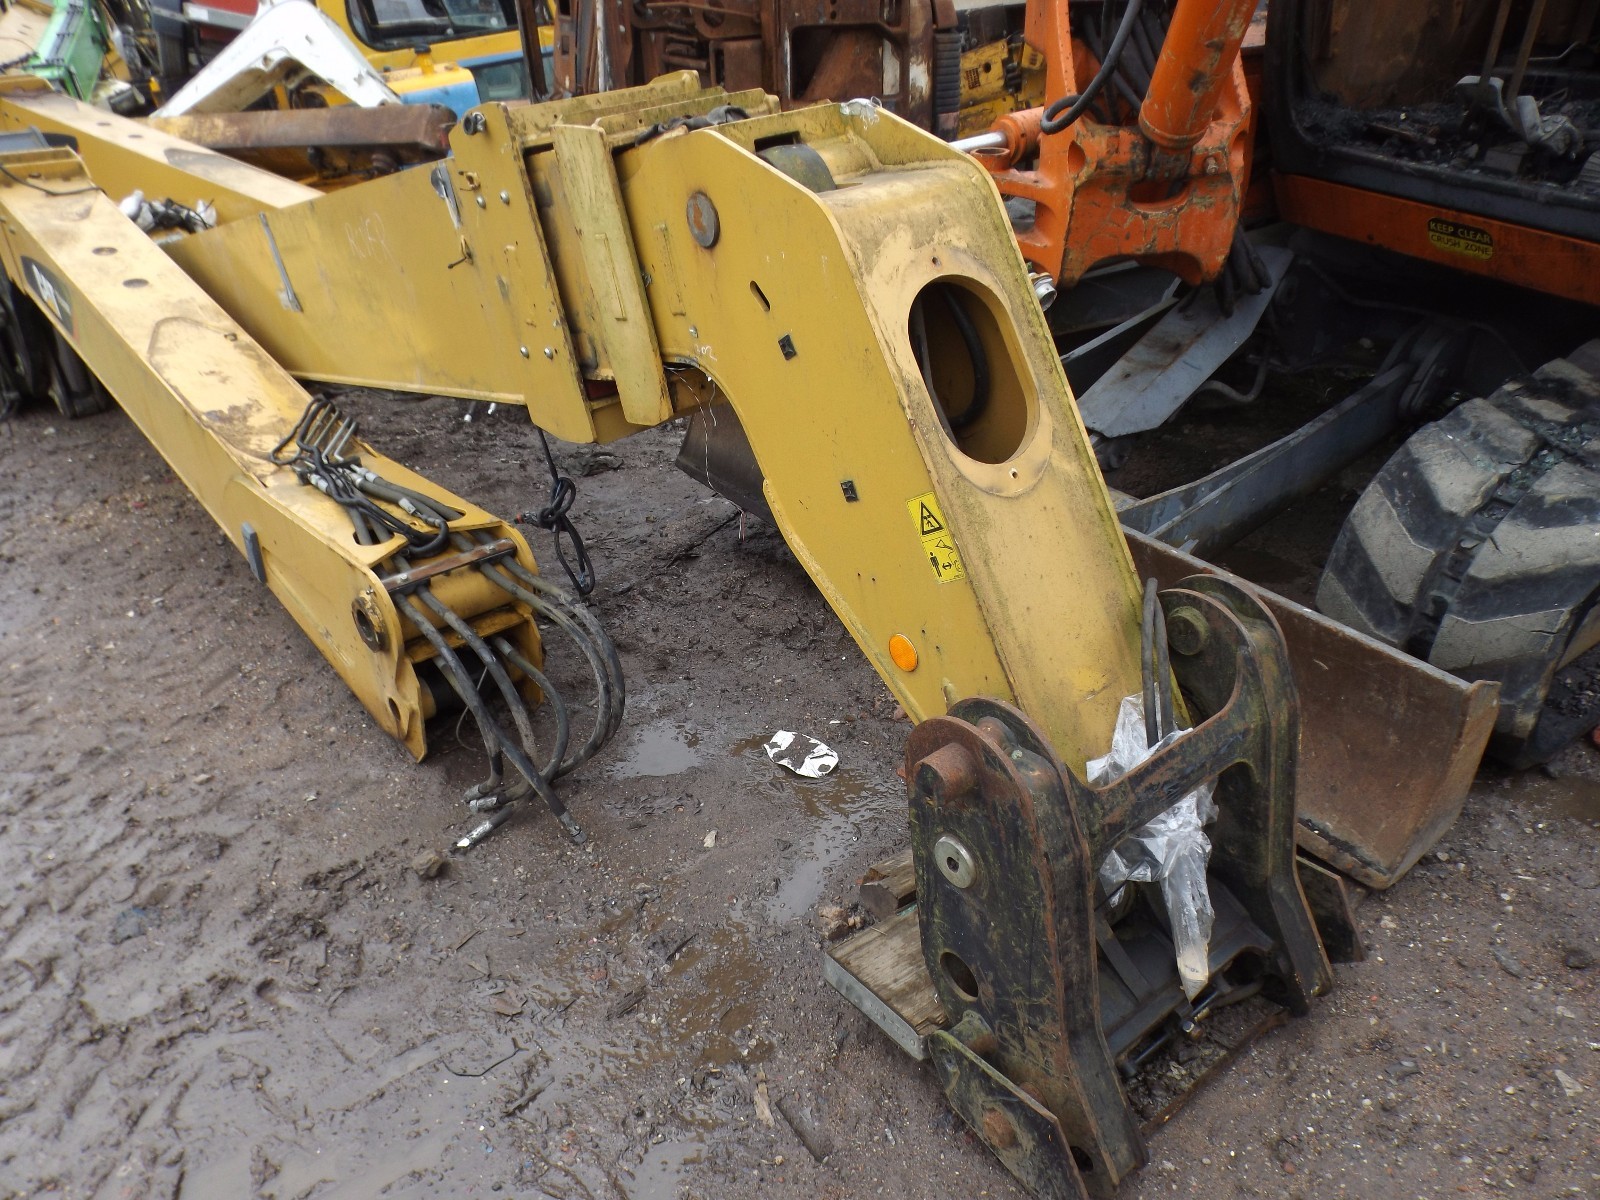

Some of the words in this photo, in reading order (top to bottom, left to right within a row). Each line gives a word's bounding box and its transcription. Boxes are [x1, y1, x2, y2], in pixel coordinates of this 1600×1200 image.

[1430, 221, 1454, 233] KEEP
[1457, 228, 1491, 244] CLEAR
[1431, 234, 1461, 248] CRUSH
[1465, 242, 1490, 256] ZONE
